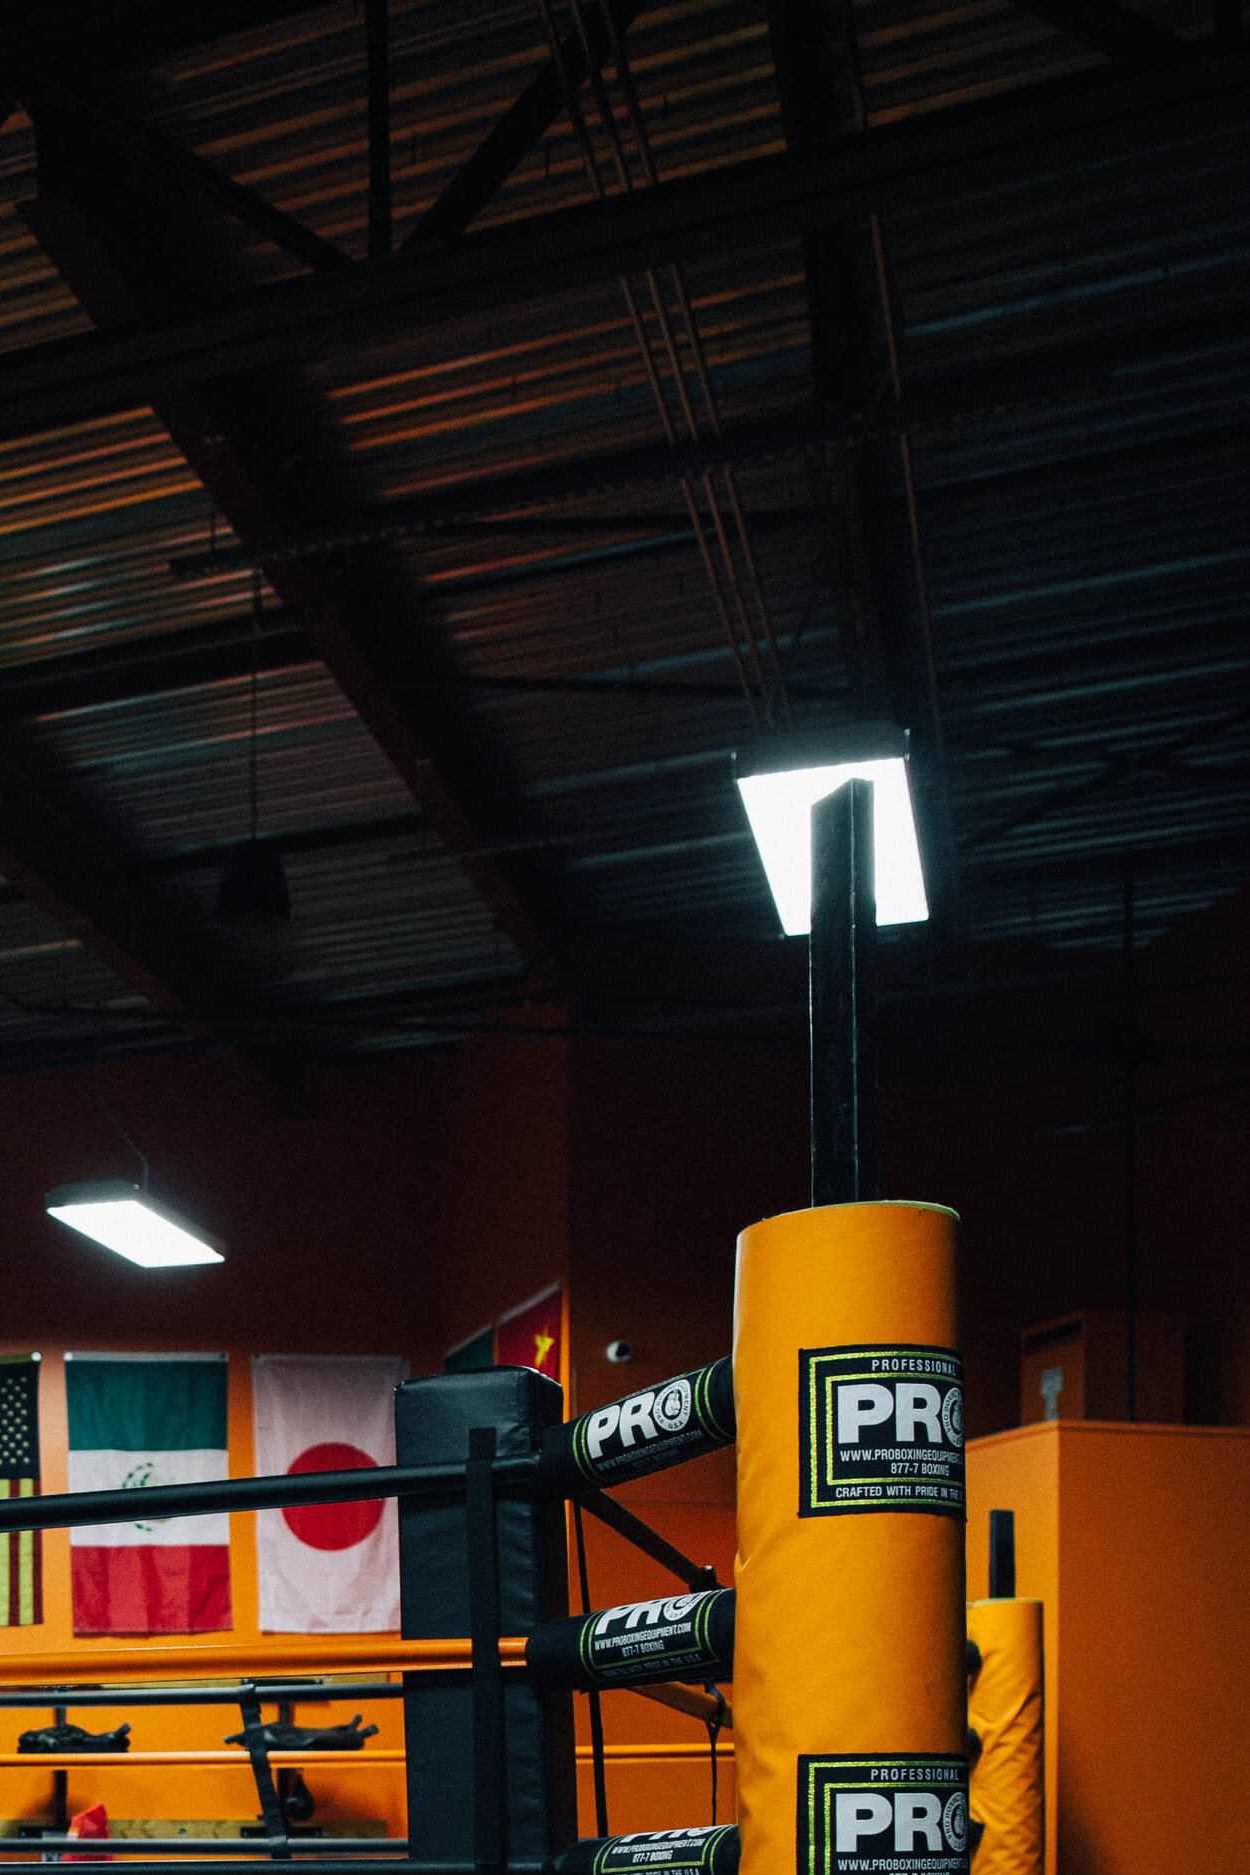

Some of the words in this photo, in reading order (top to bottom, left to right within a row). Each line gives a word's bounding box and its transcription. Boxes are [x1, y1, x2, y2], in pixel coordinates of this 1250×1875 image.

[872, 1359, 957, 1376] PROFESSIONAL
[587, 1379, 691, 1459] PRO
[890, 1463, 919, 1475] 877-7
[921, 1463, 950, 1477] BOXING
[835, 1486, 883, 1499] CRAFTED
[886, 1485, 912, 1497] WITH
[915, 1486, 939, 1498] PRIDE
[941, 1488, 948, 1498] IN
[871, 1768, 959, 1781] PROFESSIONAL
[836, 1791, 968, 1852] PRO
